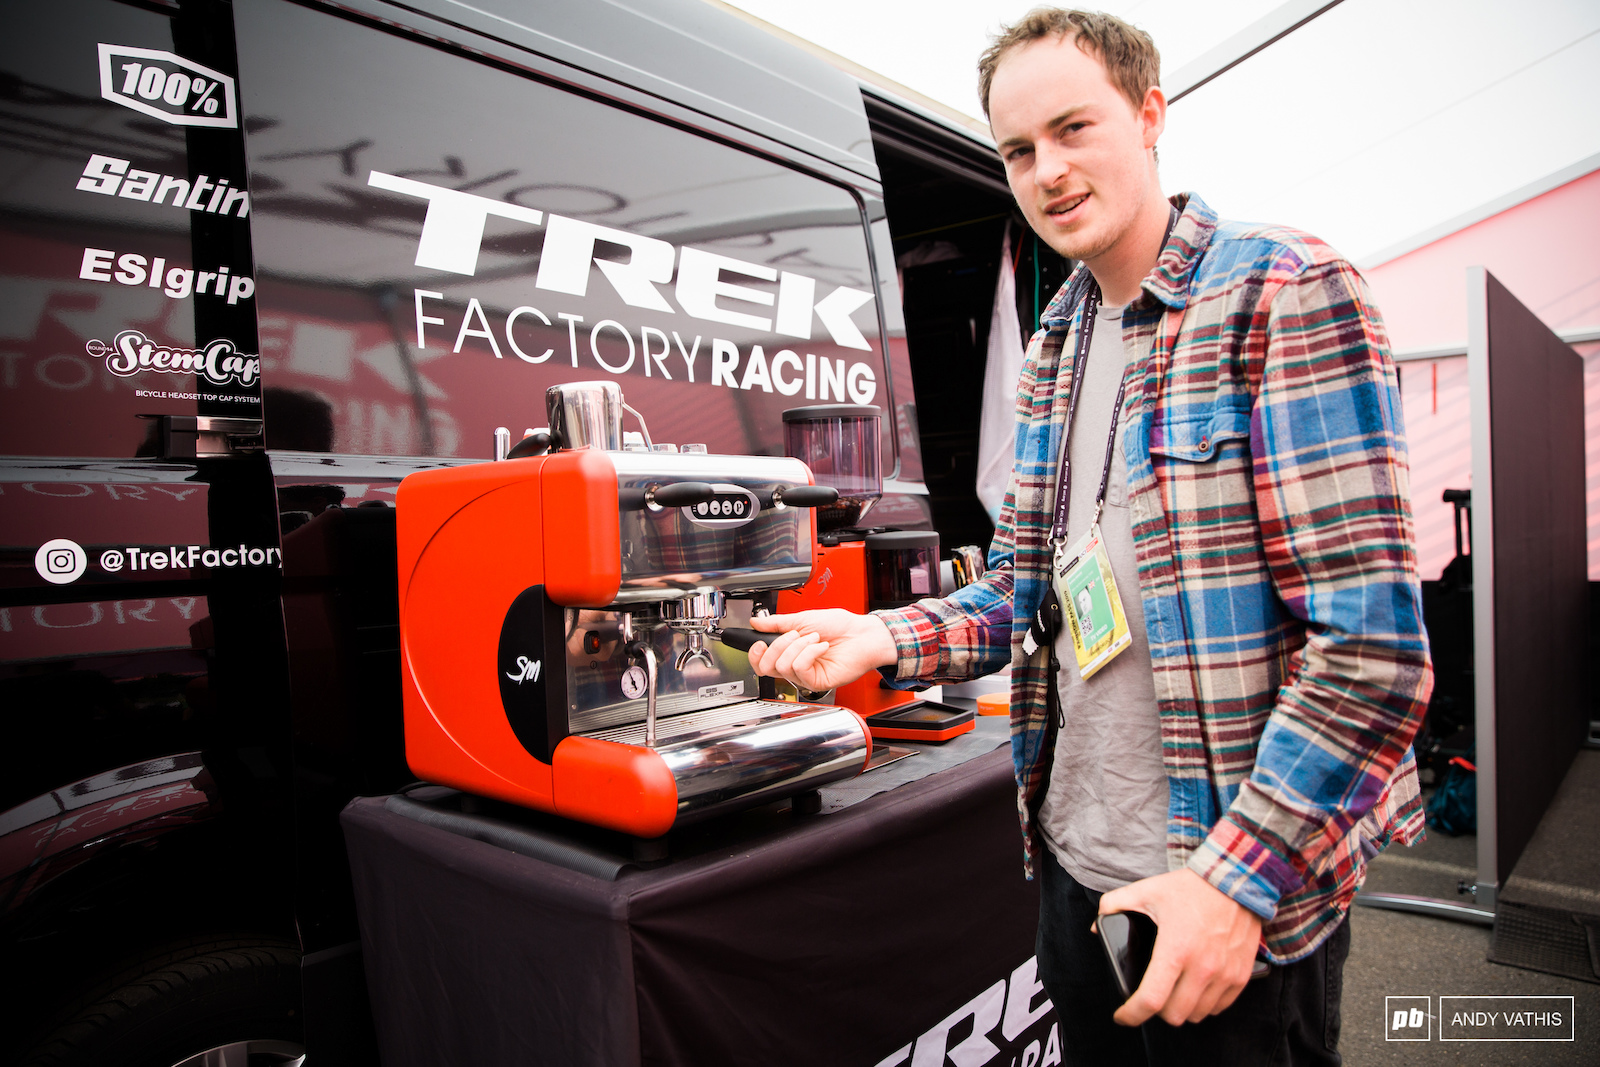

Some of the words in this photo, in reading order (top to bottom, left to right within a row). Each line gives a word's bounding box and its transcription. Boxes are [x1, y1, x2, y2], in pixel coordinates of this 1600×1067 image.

[121, 62, 219, 115] 100%
[79, 247, 255, 305] ESIgrip
[366, 169, 876, 352] TREK
[111, 334, 260, 382] StemCap
[413, 287, 702, 383] FACTORY
[711, 338, 877, 405] RACING
[135, 389, 167, 398] BICYCLE
[168, 391, 201, 400] HEADSET
[203, 393, 217, 401] TOP
[218, 394, 233, 402] CAP
[234, 396, 260, 404] SYSTEM
[873, 954, 1054, 1067] RE
